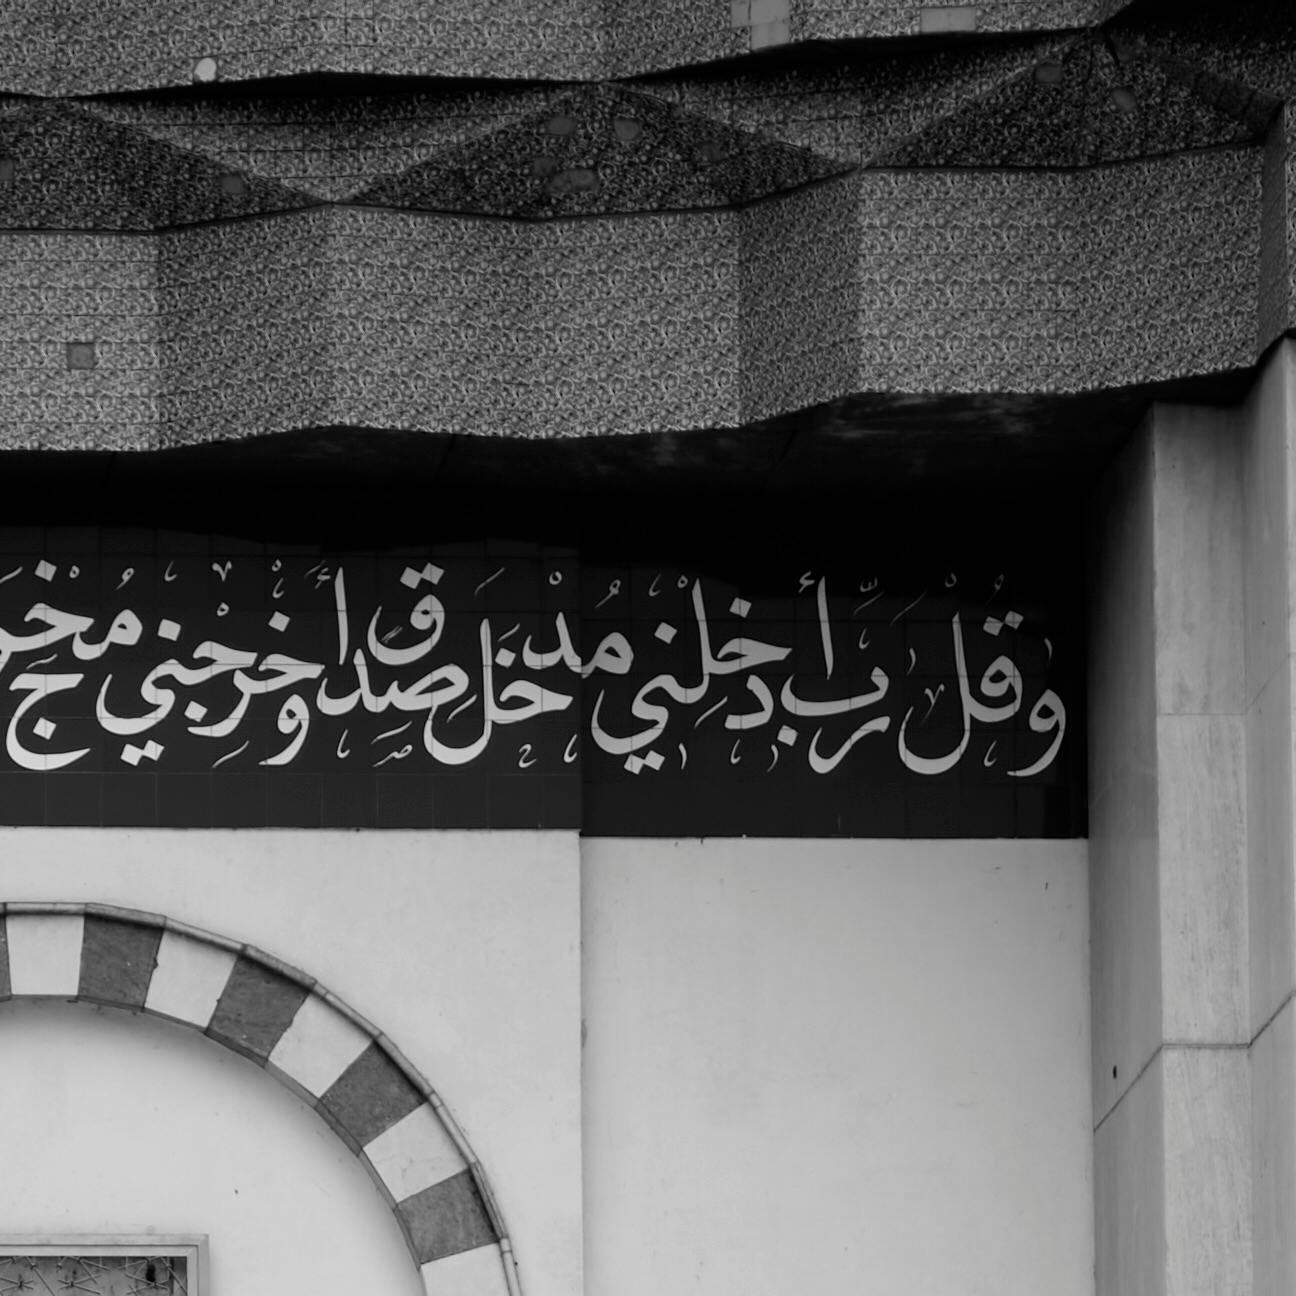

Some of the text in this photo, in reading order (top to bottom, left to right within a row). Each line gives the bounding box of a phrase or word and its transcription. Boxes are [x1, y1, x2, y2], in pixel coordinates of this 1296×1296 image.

[315, 562, 470, 722] صدق
[423, 600, 635, 766] مدخل
[777, 640, 891, 775] رب
[898, 606, 1066, 777] وقل
